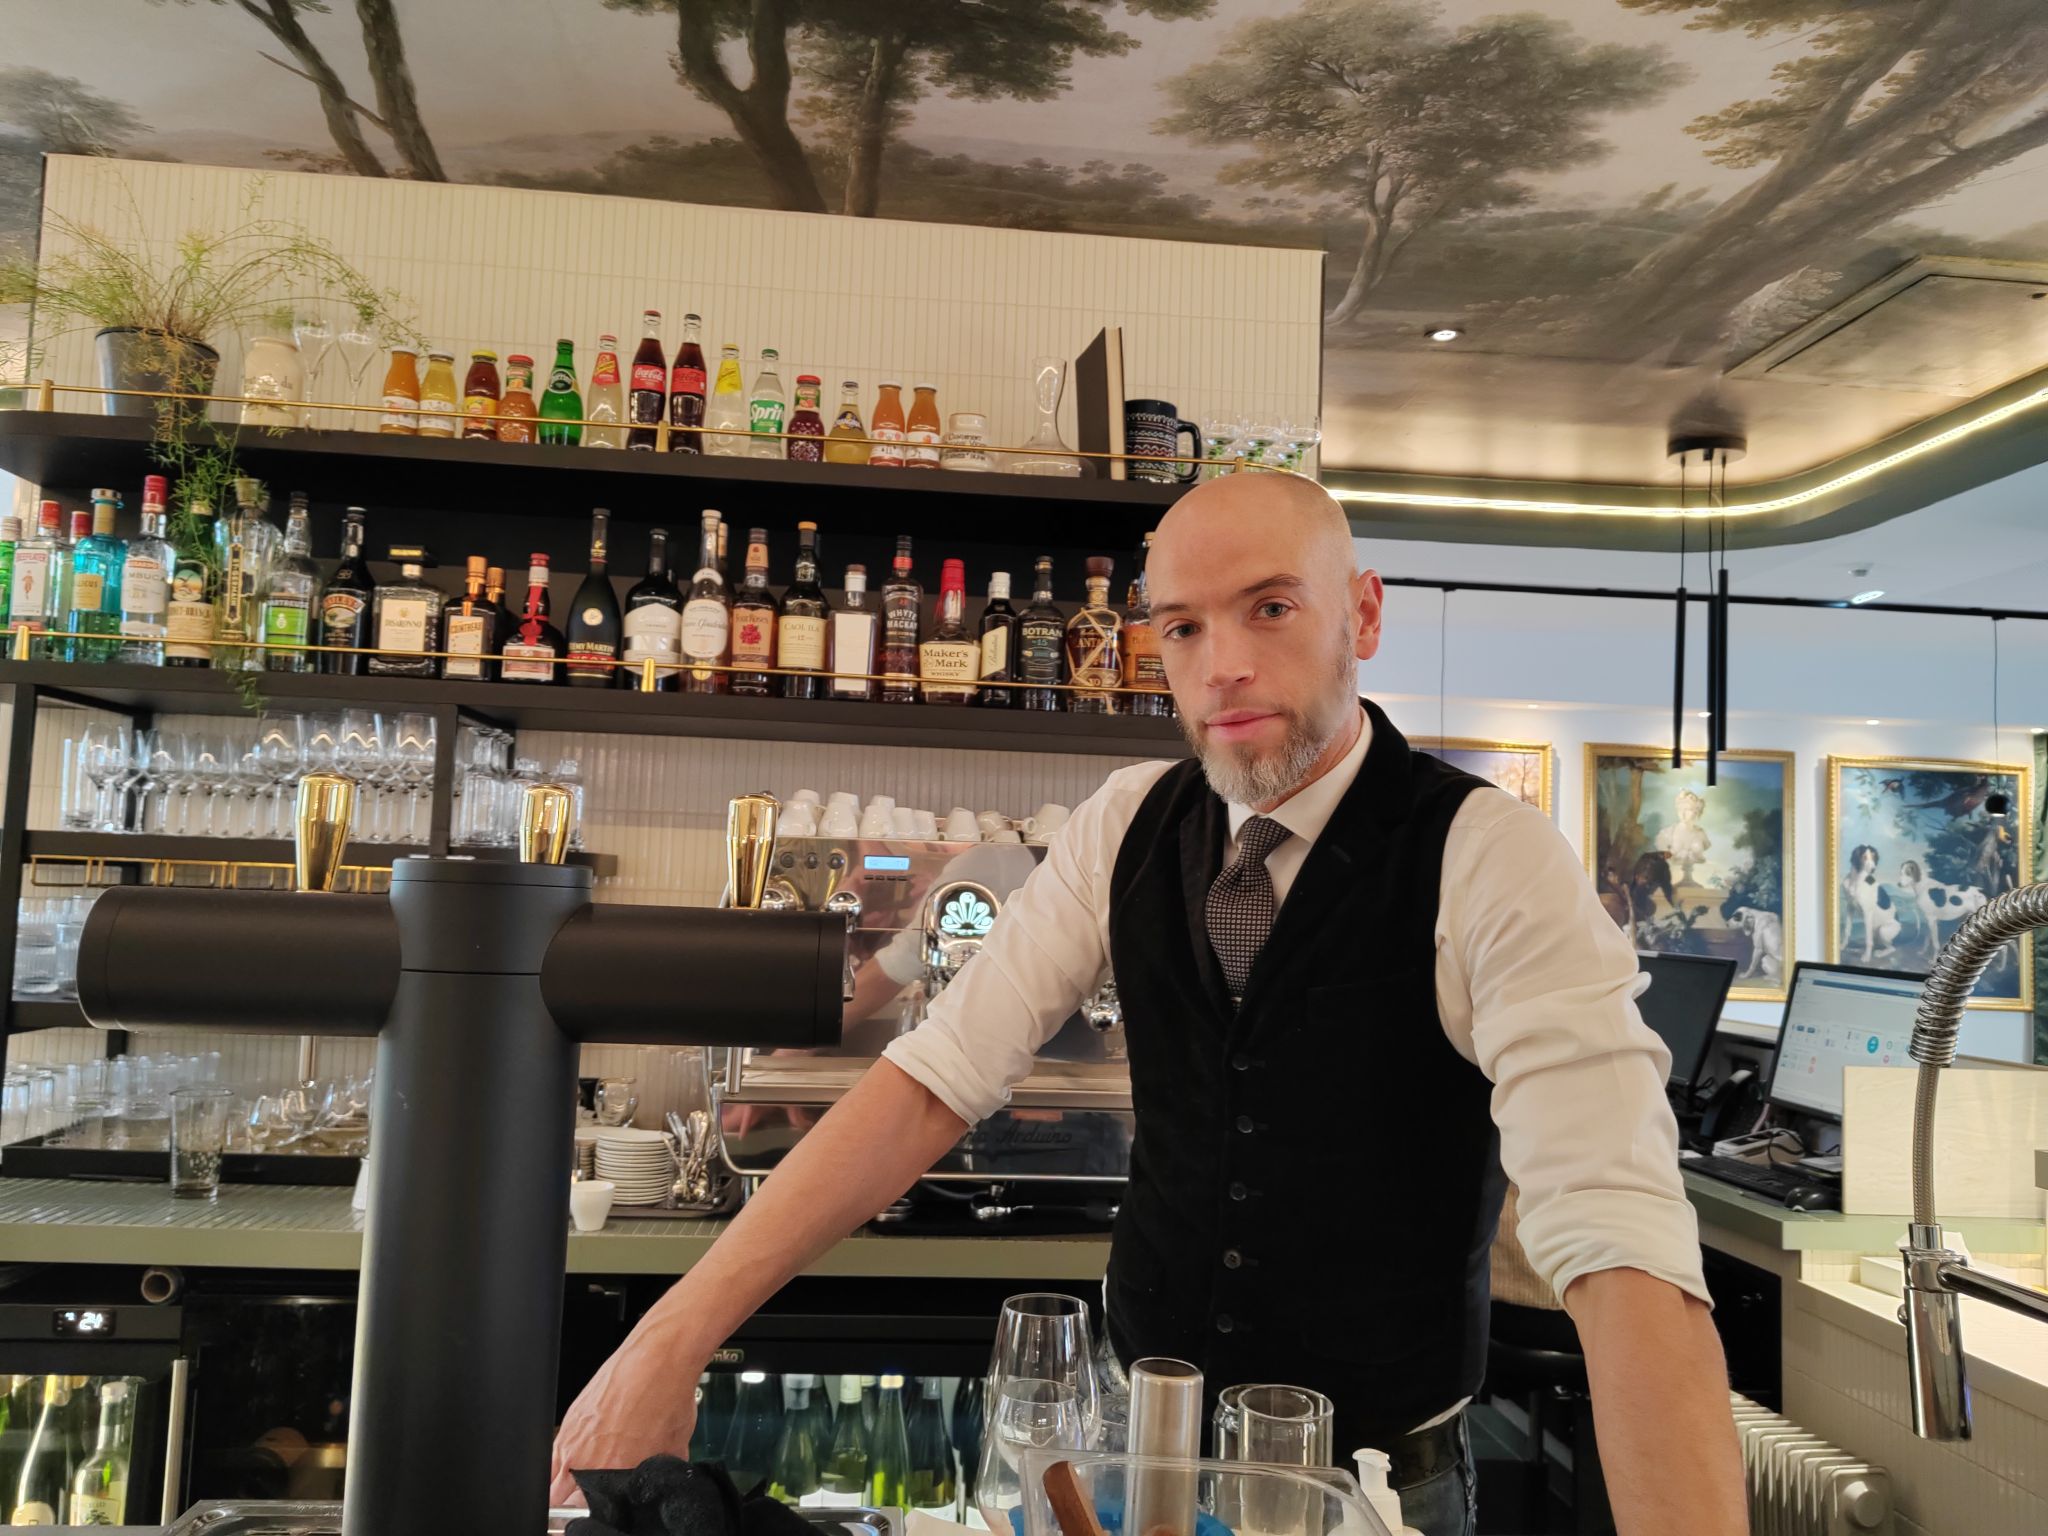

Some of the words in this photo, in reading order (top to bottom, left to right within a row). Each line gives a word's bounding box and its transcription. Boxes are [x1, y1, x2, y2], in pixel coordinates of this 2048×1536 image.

[634, 367, 664, 381] Coca-Cola
[750, 401, 784, 423] Sprit
[128, 571, 167, 583] MBUCA
[888, 608, 917, 620] WHYTE
[1022, 627, 1064, 637] BOTRAN
[923, 648, 969, 658] Maker's
[934, 658, 968, 668] Mark
[998, 1122, 1073, 1145] Arduino
